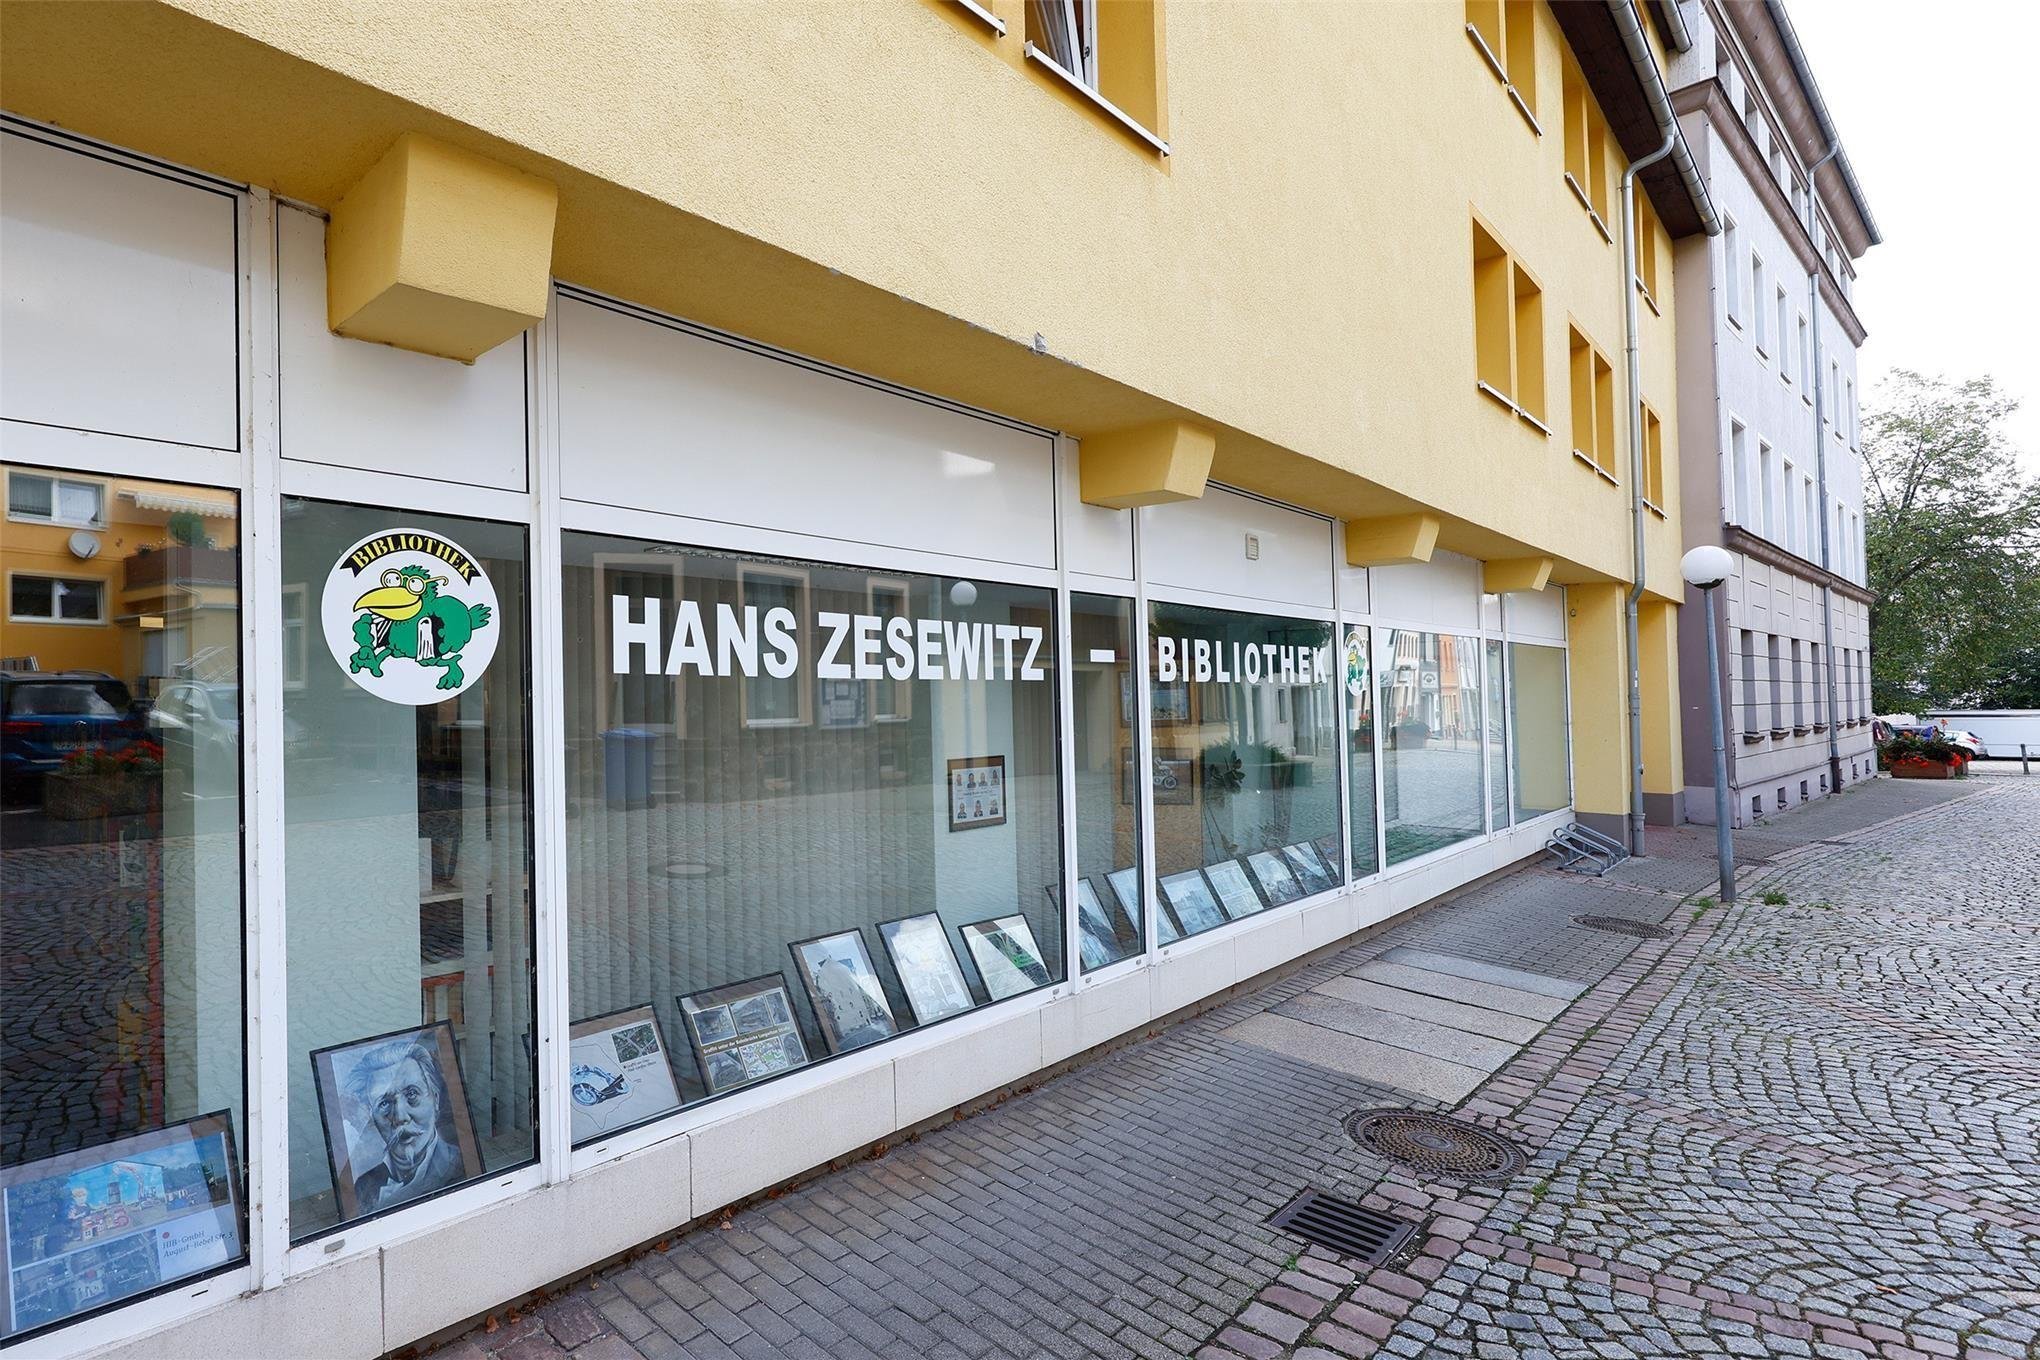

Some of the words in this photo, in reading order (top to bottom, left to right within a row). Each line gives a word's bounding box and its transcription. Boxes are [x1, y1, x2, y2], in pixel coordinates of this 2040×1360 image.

[351, 534, 476, 582] BIBLIOTHEK
[612, 594, 799, 679] HANS
[817, 611, 1044, 681] ZESEWITZ
[1157, 636, 1328, 684] BIBLIOTHEK
